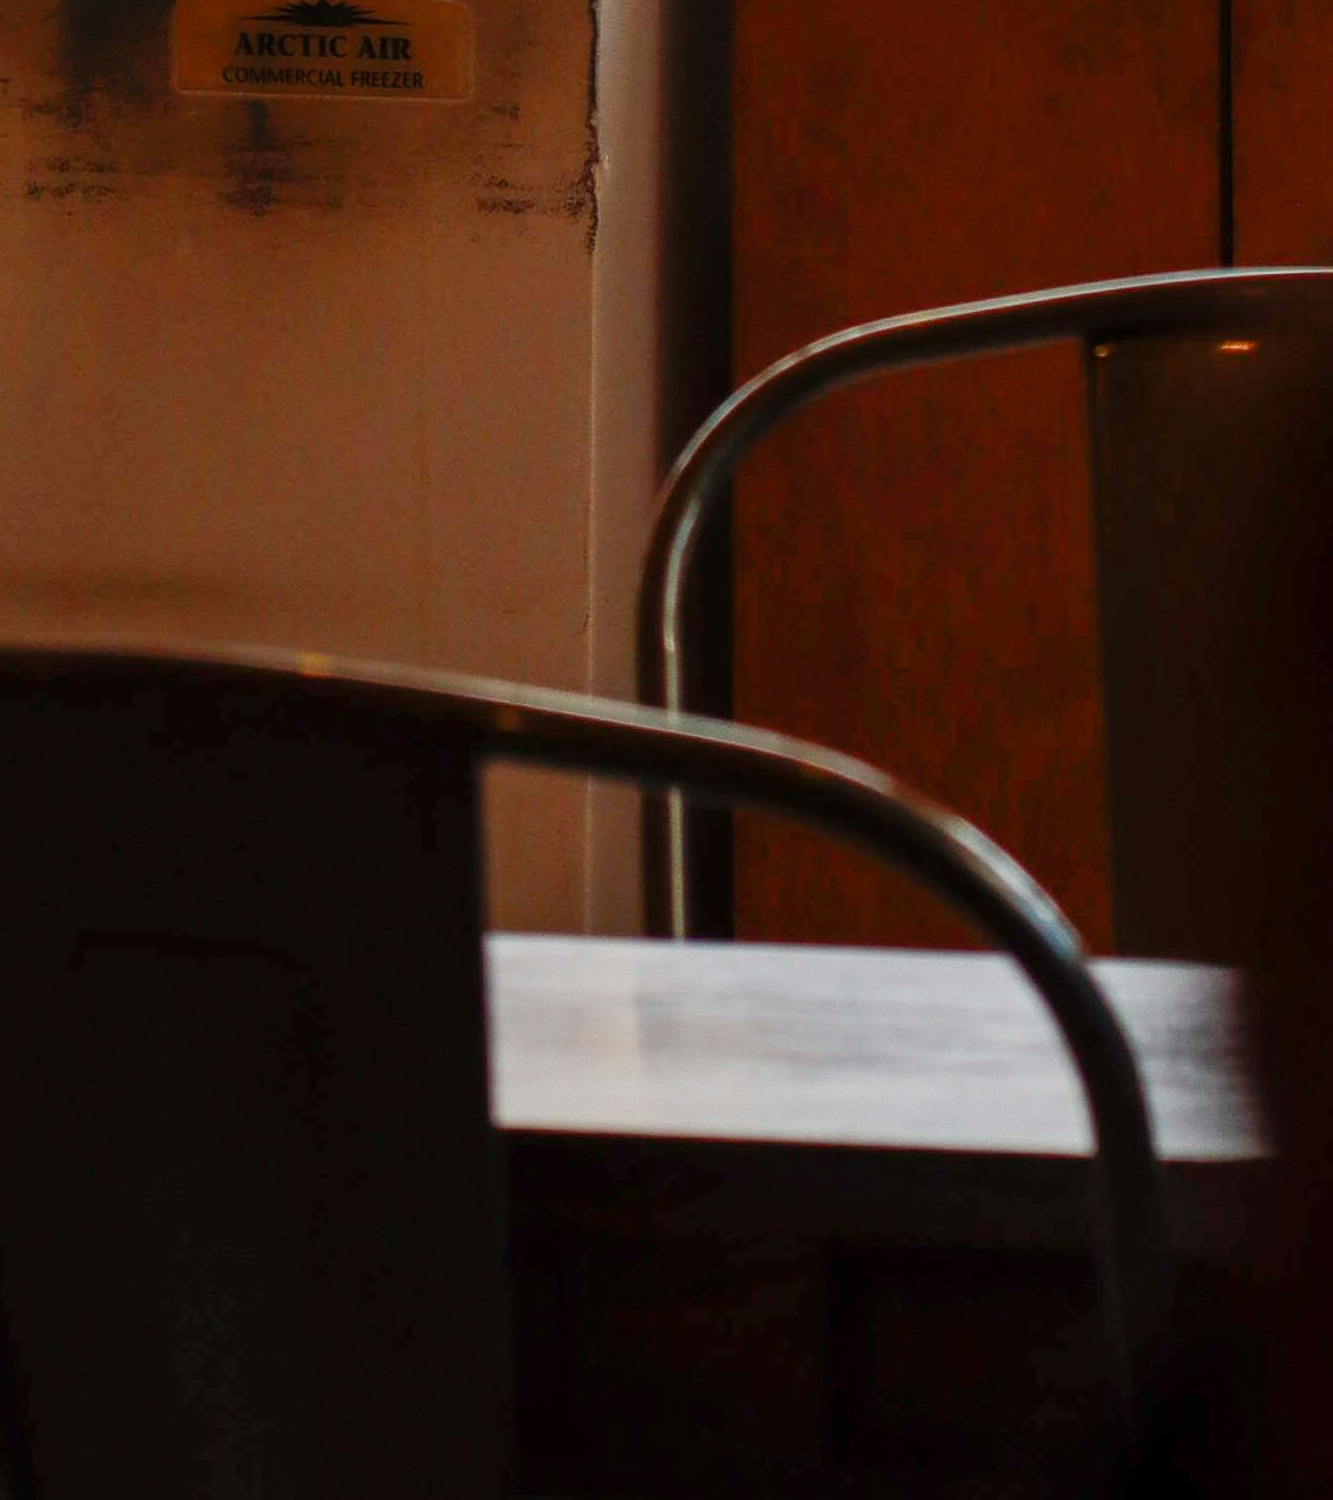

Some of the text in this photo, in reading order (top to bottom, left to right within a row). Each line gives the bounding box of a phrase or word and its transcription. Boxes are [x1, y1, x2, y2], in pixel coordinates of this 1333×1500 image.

[234, 31, 413, 61] ARCTIC AIR
[221, 65, 425, 90] COMMERCIAL FREEZER
